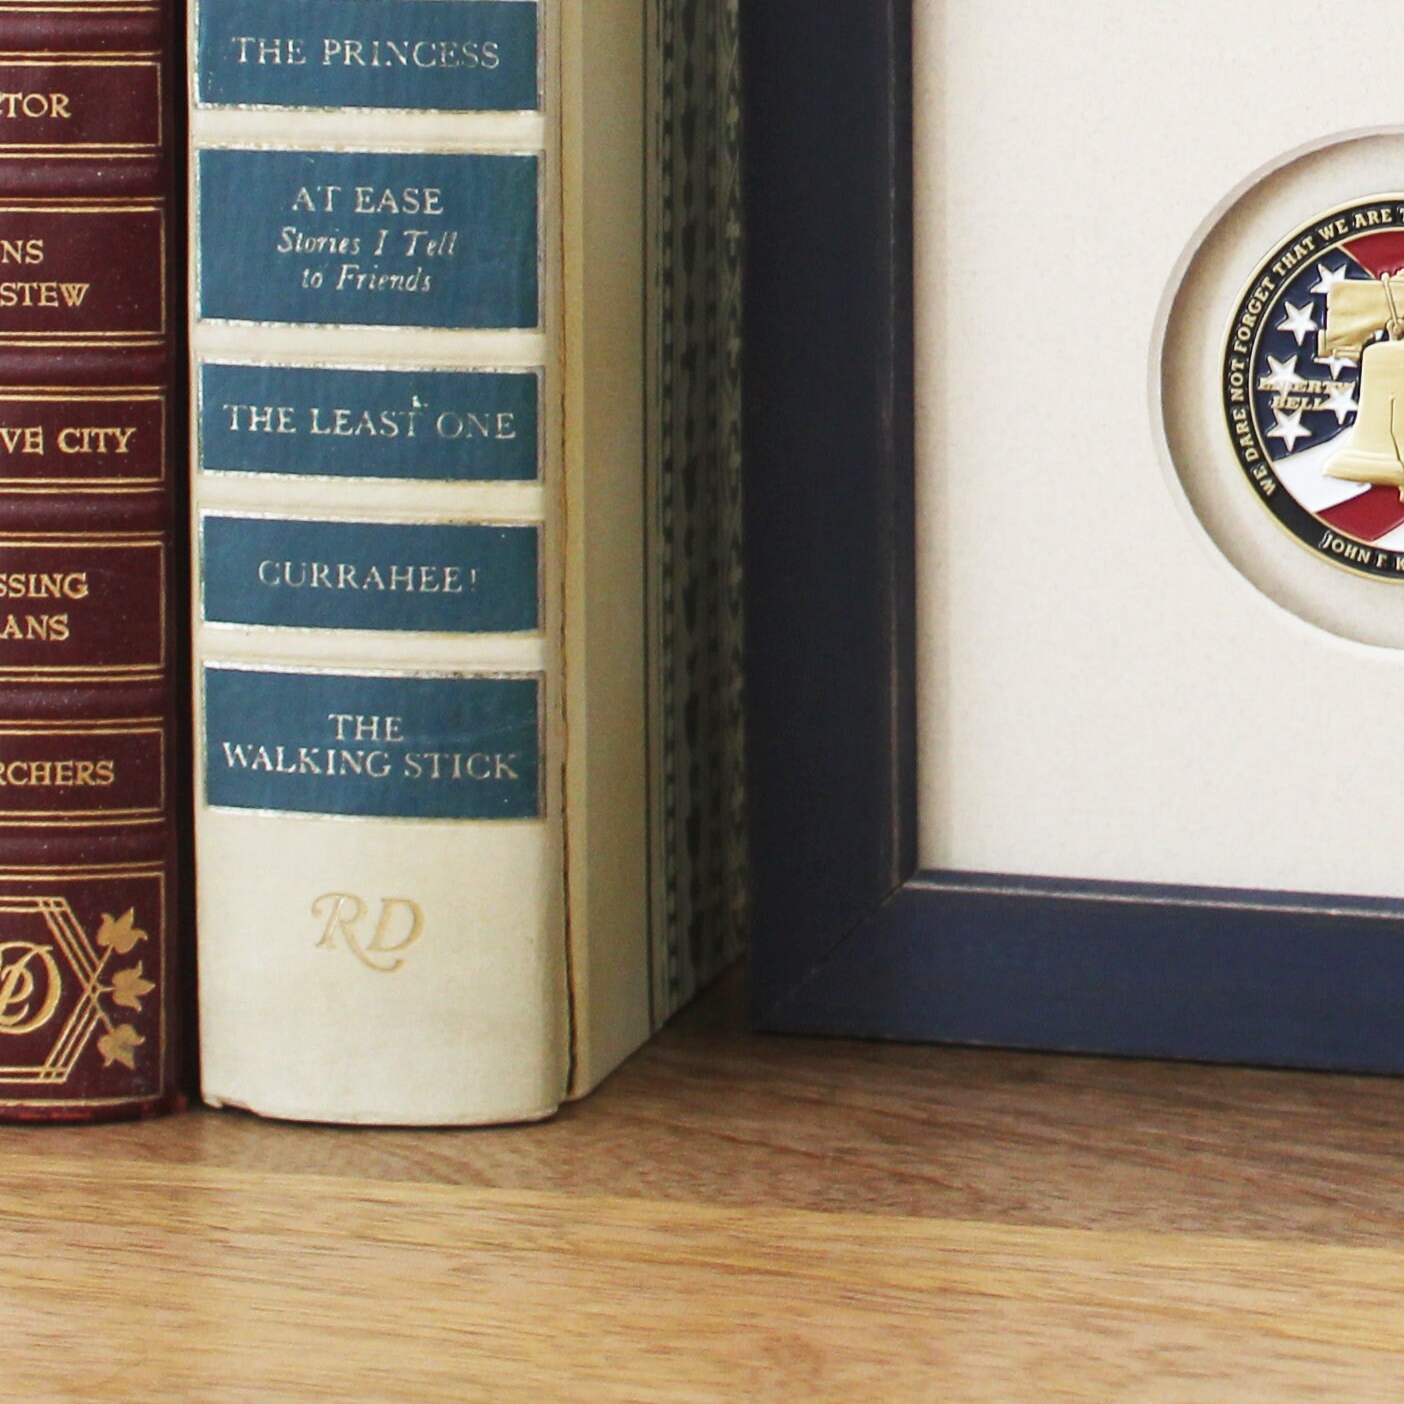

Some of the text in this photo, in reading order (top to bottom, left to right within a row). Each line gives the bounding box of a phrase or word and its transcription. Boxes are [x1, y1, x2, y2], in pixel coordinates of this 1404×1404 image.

[231, 37, 500, 69] THE PRINCESS
[0, 93, 72, 118] TOR
[291, 186, 444, 214] AT EASE
[1317, 218, 1348, 241] WE
[1353, 208, 1393, 228] ARE
[1, 239, 44, 265] NS
[277, 226, 458, 256] Stories I Tell
[1272, 236, 1316, 277] THAT
[302, 263, 432, 292] to Friends
[0, 282, 90, 307] STEW
[1234, 276, 1276, 354] FORGET
[1230, 359, 1246, 402] NOT
[223, 403, 516, 439] THE LEAST ONE
[1233, 408, 1259, 463] DARE
[57, 426, 137, 455] CITY
[1253, 464, 1277, 496] WE
[1321, 533, 1371, 564] JOHN
[258, 559, 480, 593] CURRAHEE!
[328, 713, 404, 743] THE
[222, 741, 519, 781] WALKING STICK
[311, 891, 426, 973] RD
